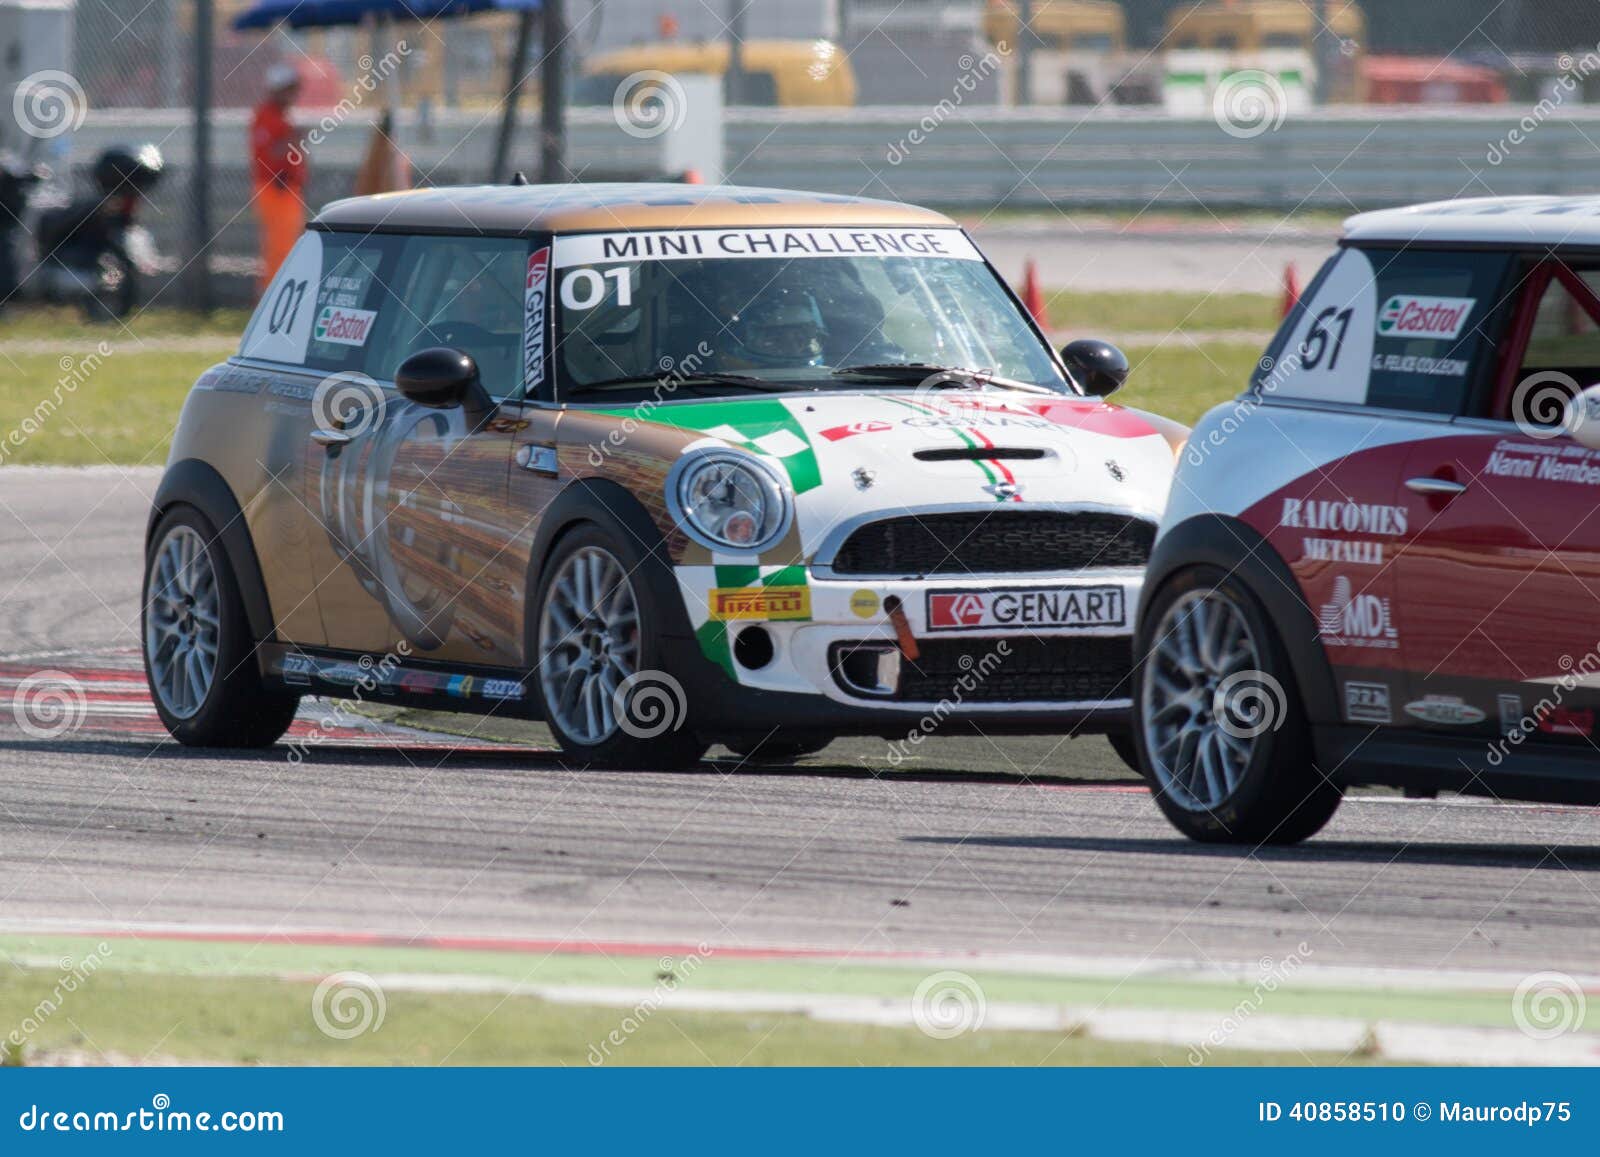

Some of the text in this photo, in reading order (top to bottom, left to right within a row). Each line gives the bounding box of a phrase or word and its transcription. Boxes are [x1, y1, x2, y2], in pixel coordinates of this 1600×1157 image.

[603, 232, 950, 258] MINI CHALLENGE
[560, 267, 632, 311] 01
[269, 278, 308, 335] 01
[1397, 300, 1467, 333] Castrol
[326, 310, 372, 341] Castrol
[526, 290, 544, 386] GENART
[1301, 306, 1354, 371] 61
[1485, 451, 1537, 478] Nanni
[1303, 537, 1383, 564] METALLI
[716, 591, 802, 613] PIRELLI
[992, 592, 1117, 623] GENART
